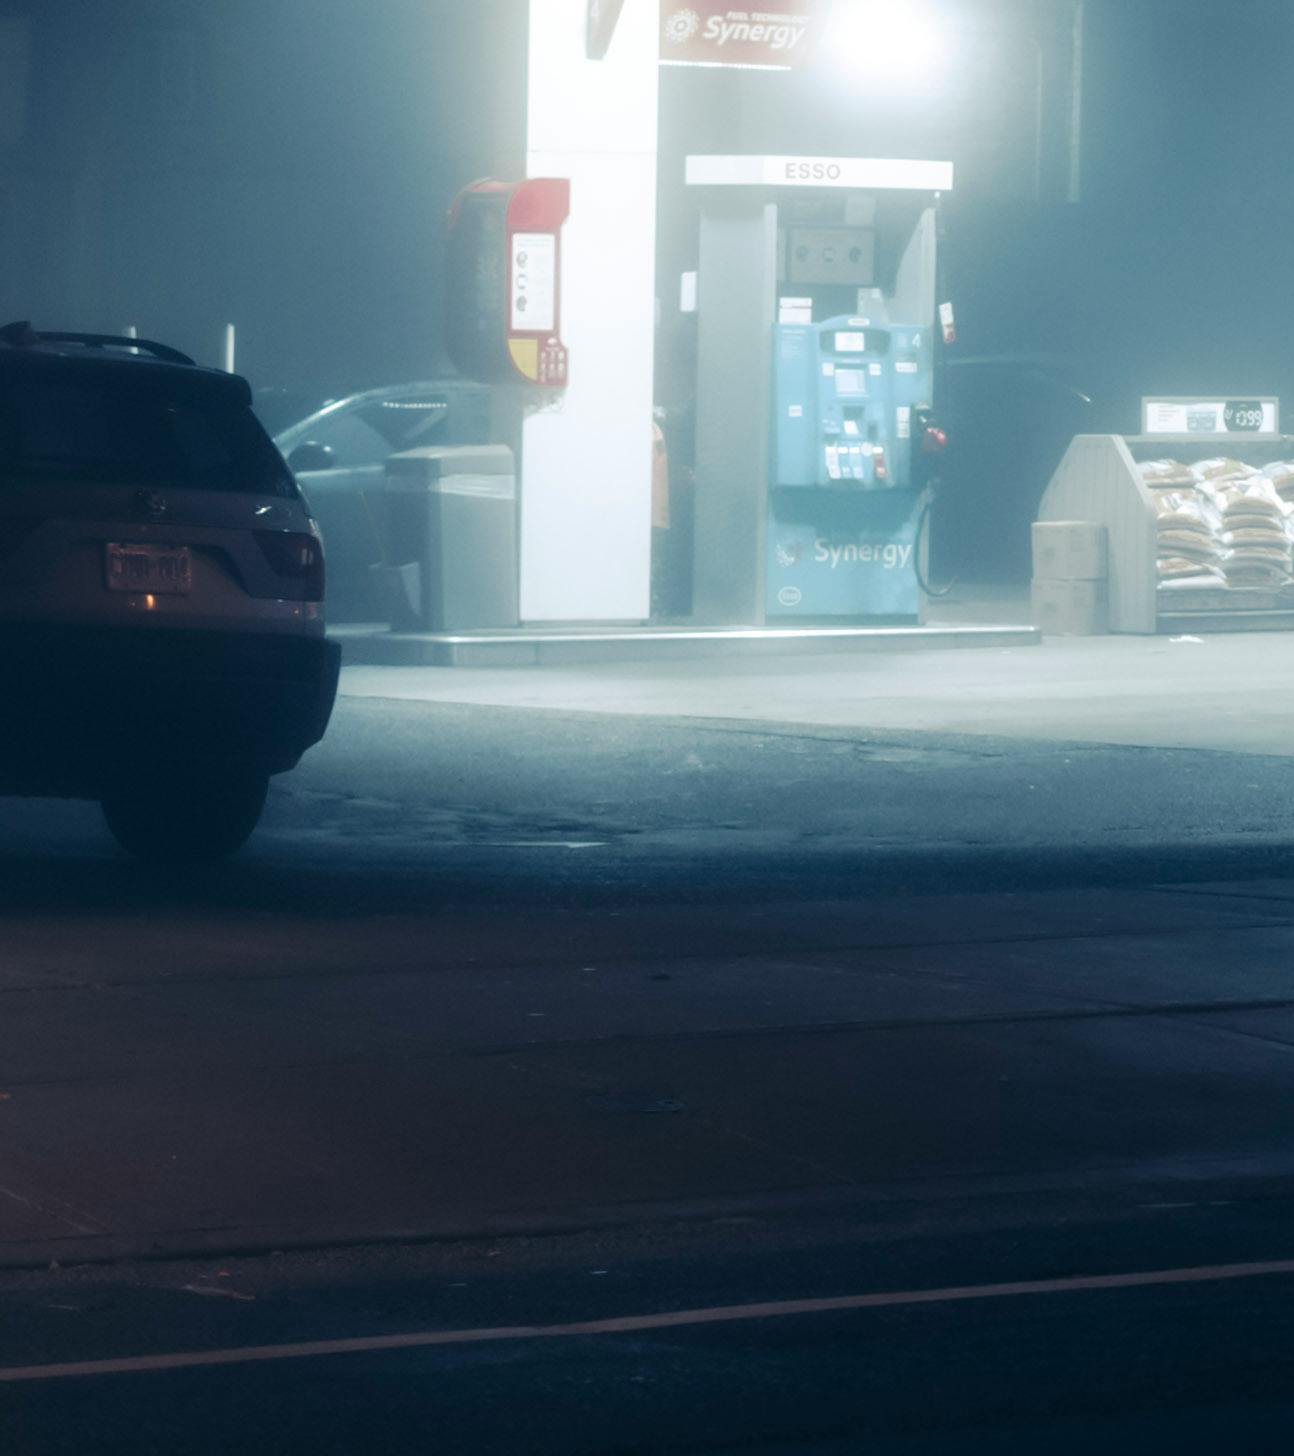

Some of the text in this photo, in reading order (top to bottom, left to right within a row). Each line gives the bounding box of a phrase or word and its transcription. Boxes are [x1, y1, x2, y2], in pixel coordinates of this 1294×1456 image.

[702, 15, 806, 49] Synergy
[785, 162, 841, 180] ESSO
[912, 333, 921, 348] 4
[814, 537, 913, 569] Synergy
